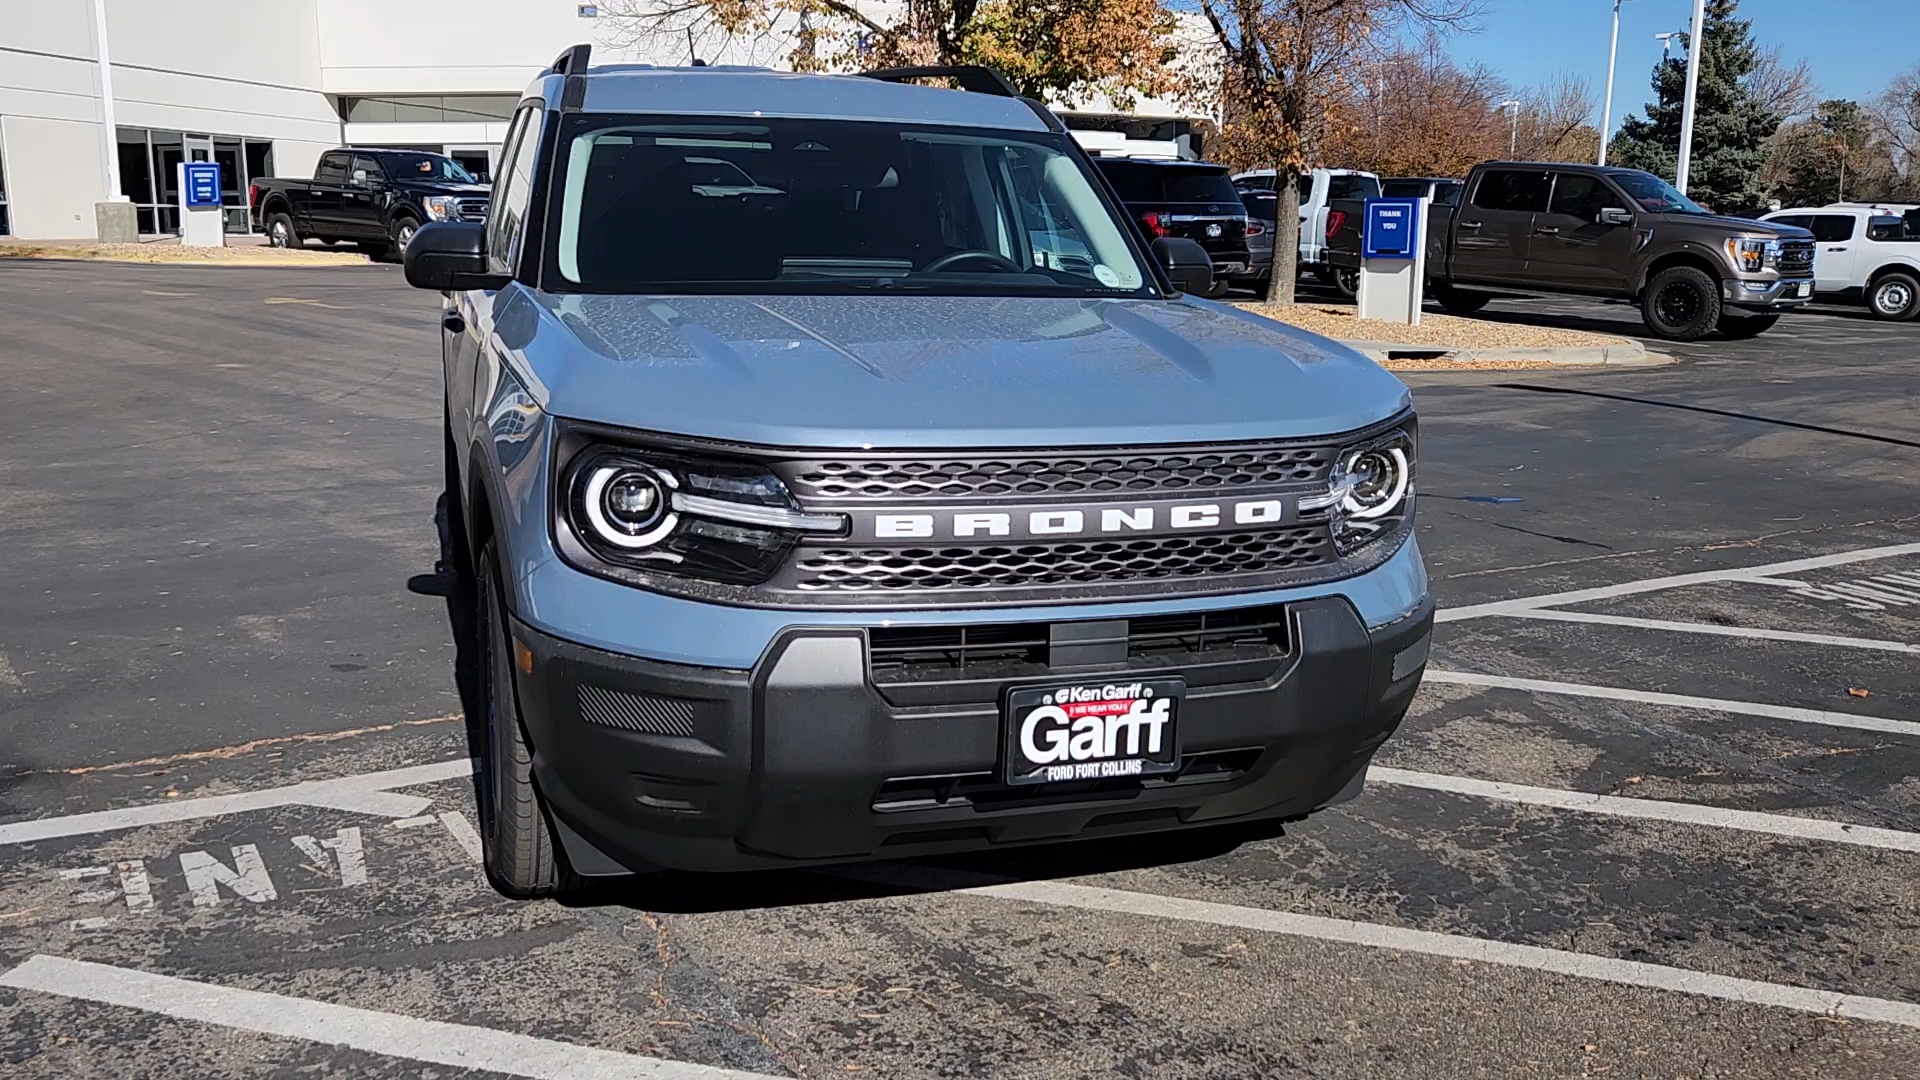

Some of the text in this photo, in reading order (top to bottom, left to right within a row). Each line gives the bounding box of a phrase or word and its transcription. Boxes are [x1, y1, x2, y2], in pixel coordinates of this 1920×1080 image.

[1382, 222, 1397, 230] YOU
[874, 499, 1282, 538] BRONCO
[1069, 686, 1101, 703] Ken
[1102, 683, 1142, 700] Garff
[1020, 698, 1170, 764] Garff
[1048, 760, 1142, 781] FORD FORT COLLINS
